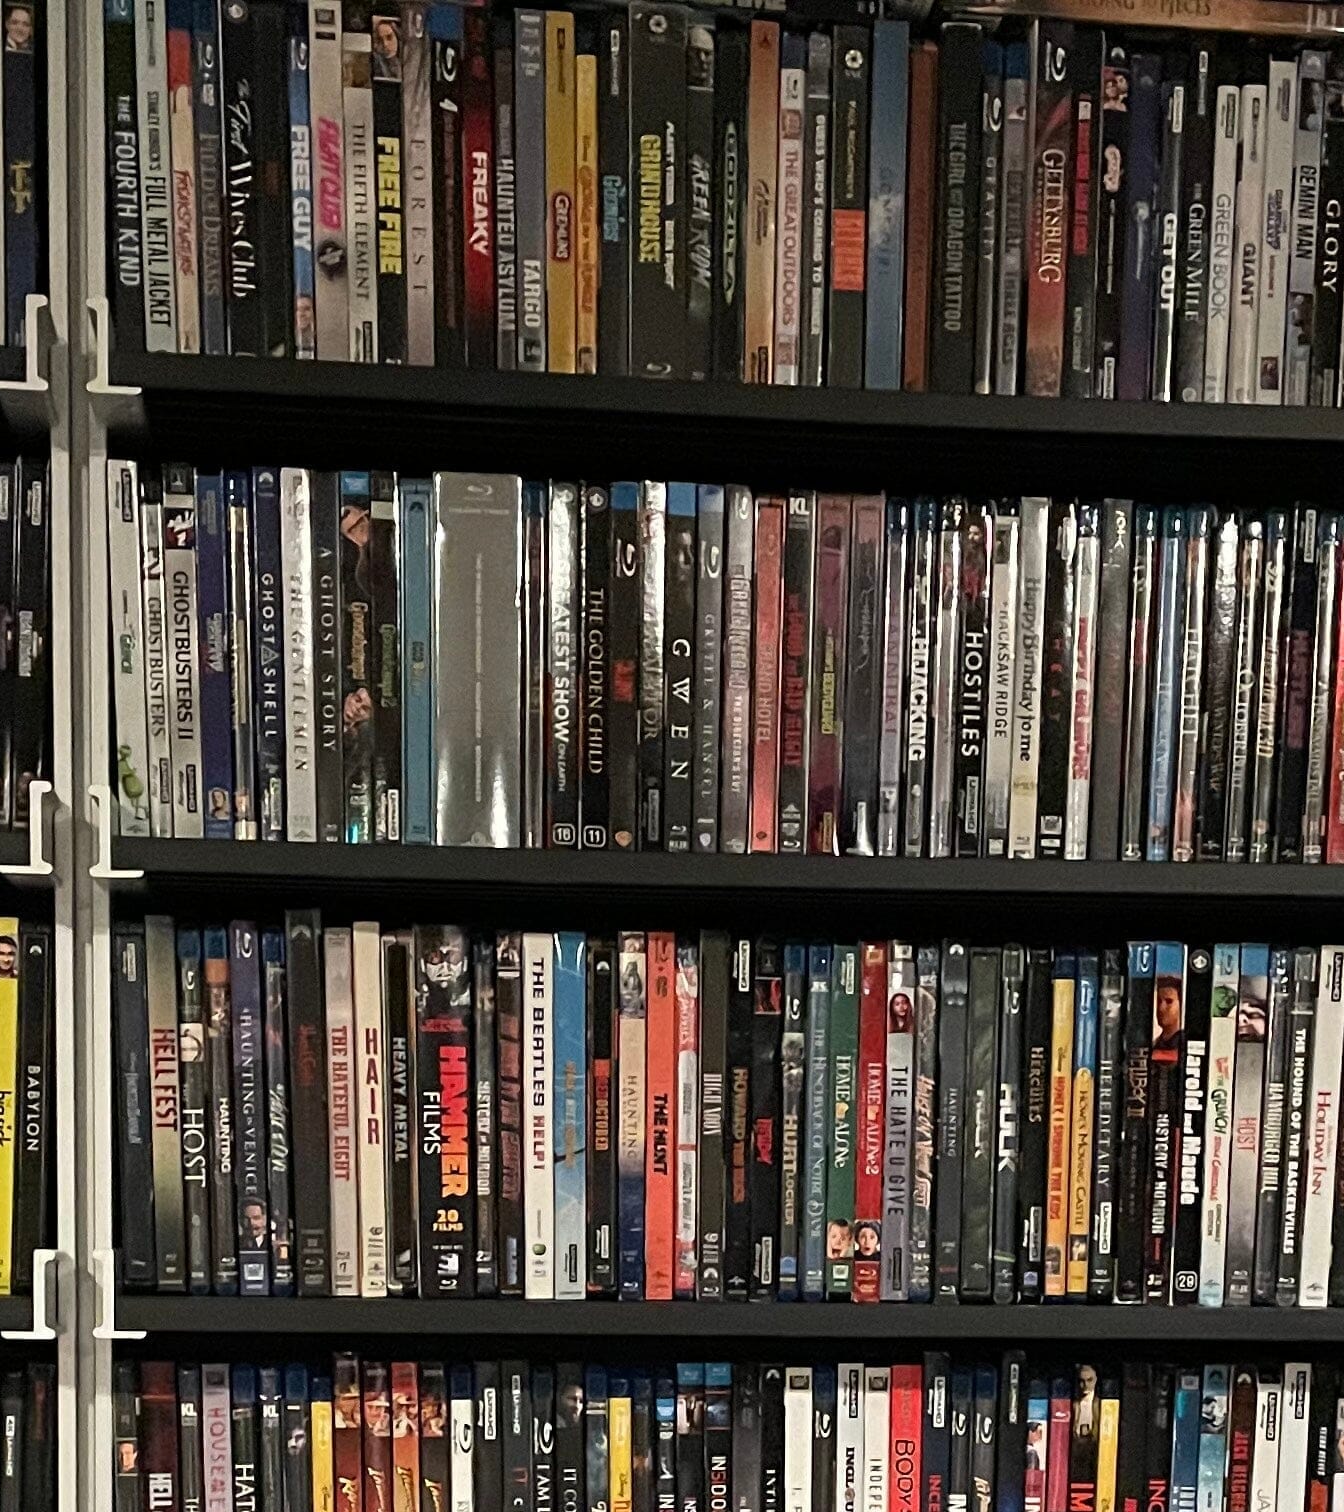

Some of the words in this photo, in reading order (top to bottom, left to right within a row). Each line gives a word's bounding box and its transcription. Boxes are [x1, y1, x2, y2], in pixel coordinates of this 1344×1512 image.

[377, 137, 399, 208] FREE
[470, 151, 490, 254] FREAKY
[379, 214, 400, 274] FIRE
[1322, 199, 1341, 292] GLORY
[522, 260, 542, 328] FARGO
[171, 570, 193, 721] GHOSTBUSTERS
[670, 638, 690, 781] GWEN
[960, 631, 984, 757] HOSTILES
[176, 727, 194, 741] II
[531, 958, 545, 1000] THE
[153, 1028, 175, 1079] HELL
[391, 1037, 407, 1094] HEAVY
[531, 1007, 545, 1106] BEATLES
[25, 1064, 42, 1152] BABYLON
[154, 1084, 178, 1132] FEST
[392, 1105, 408, 1162] METAL
[423, 1091, 440, 1154] FILMS
[440, 1045, 468, 1198] HAMMER
[182, 1108, 205, 1187] HOST
[531, 1116, 545, 1170] HELP!
